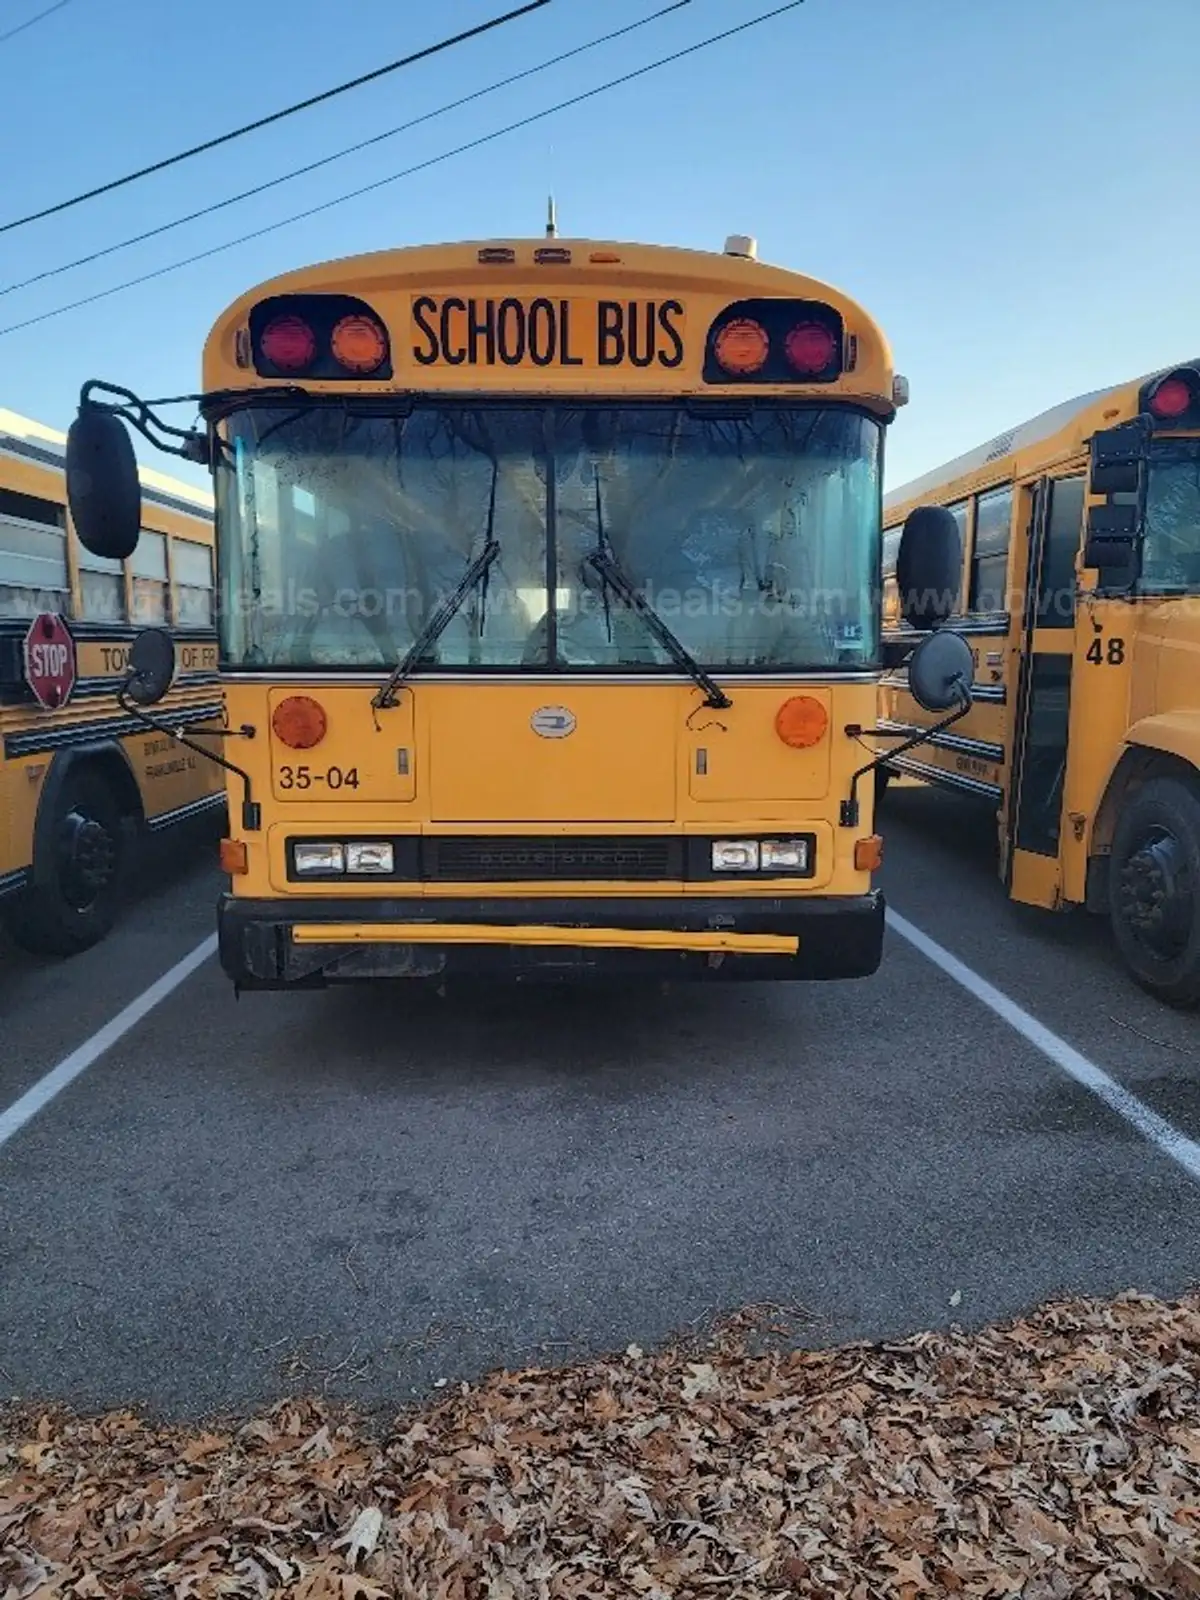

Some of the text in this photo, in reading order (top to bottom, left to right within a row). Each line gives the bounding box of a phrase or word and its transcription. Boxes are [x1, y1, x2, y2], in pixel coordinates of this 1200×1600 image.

[412, 296, 685, 368] SCHOOL BUS
[31, 643, 68, 678] STOP
[182, 647, 199, 667] OF
[1086, 637, 1125, 666] 48
[279, 765, 360, 790] 35-04
